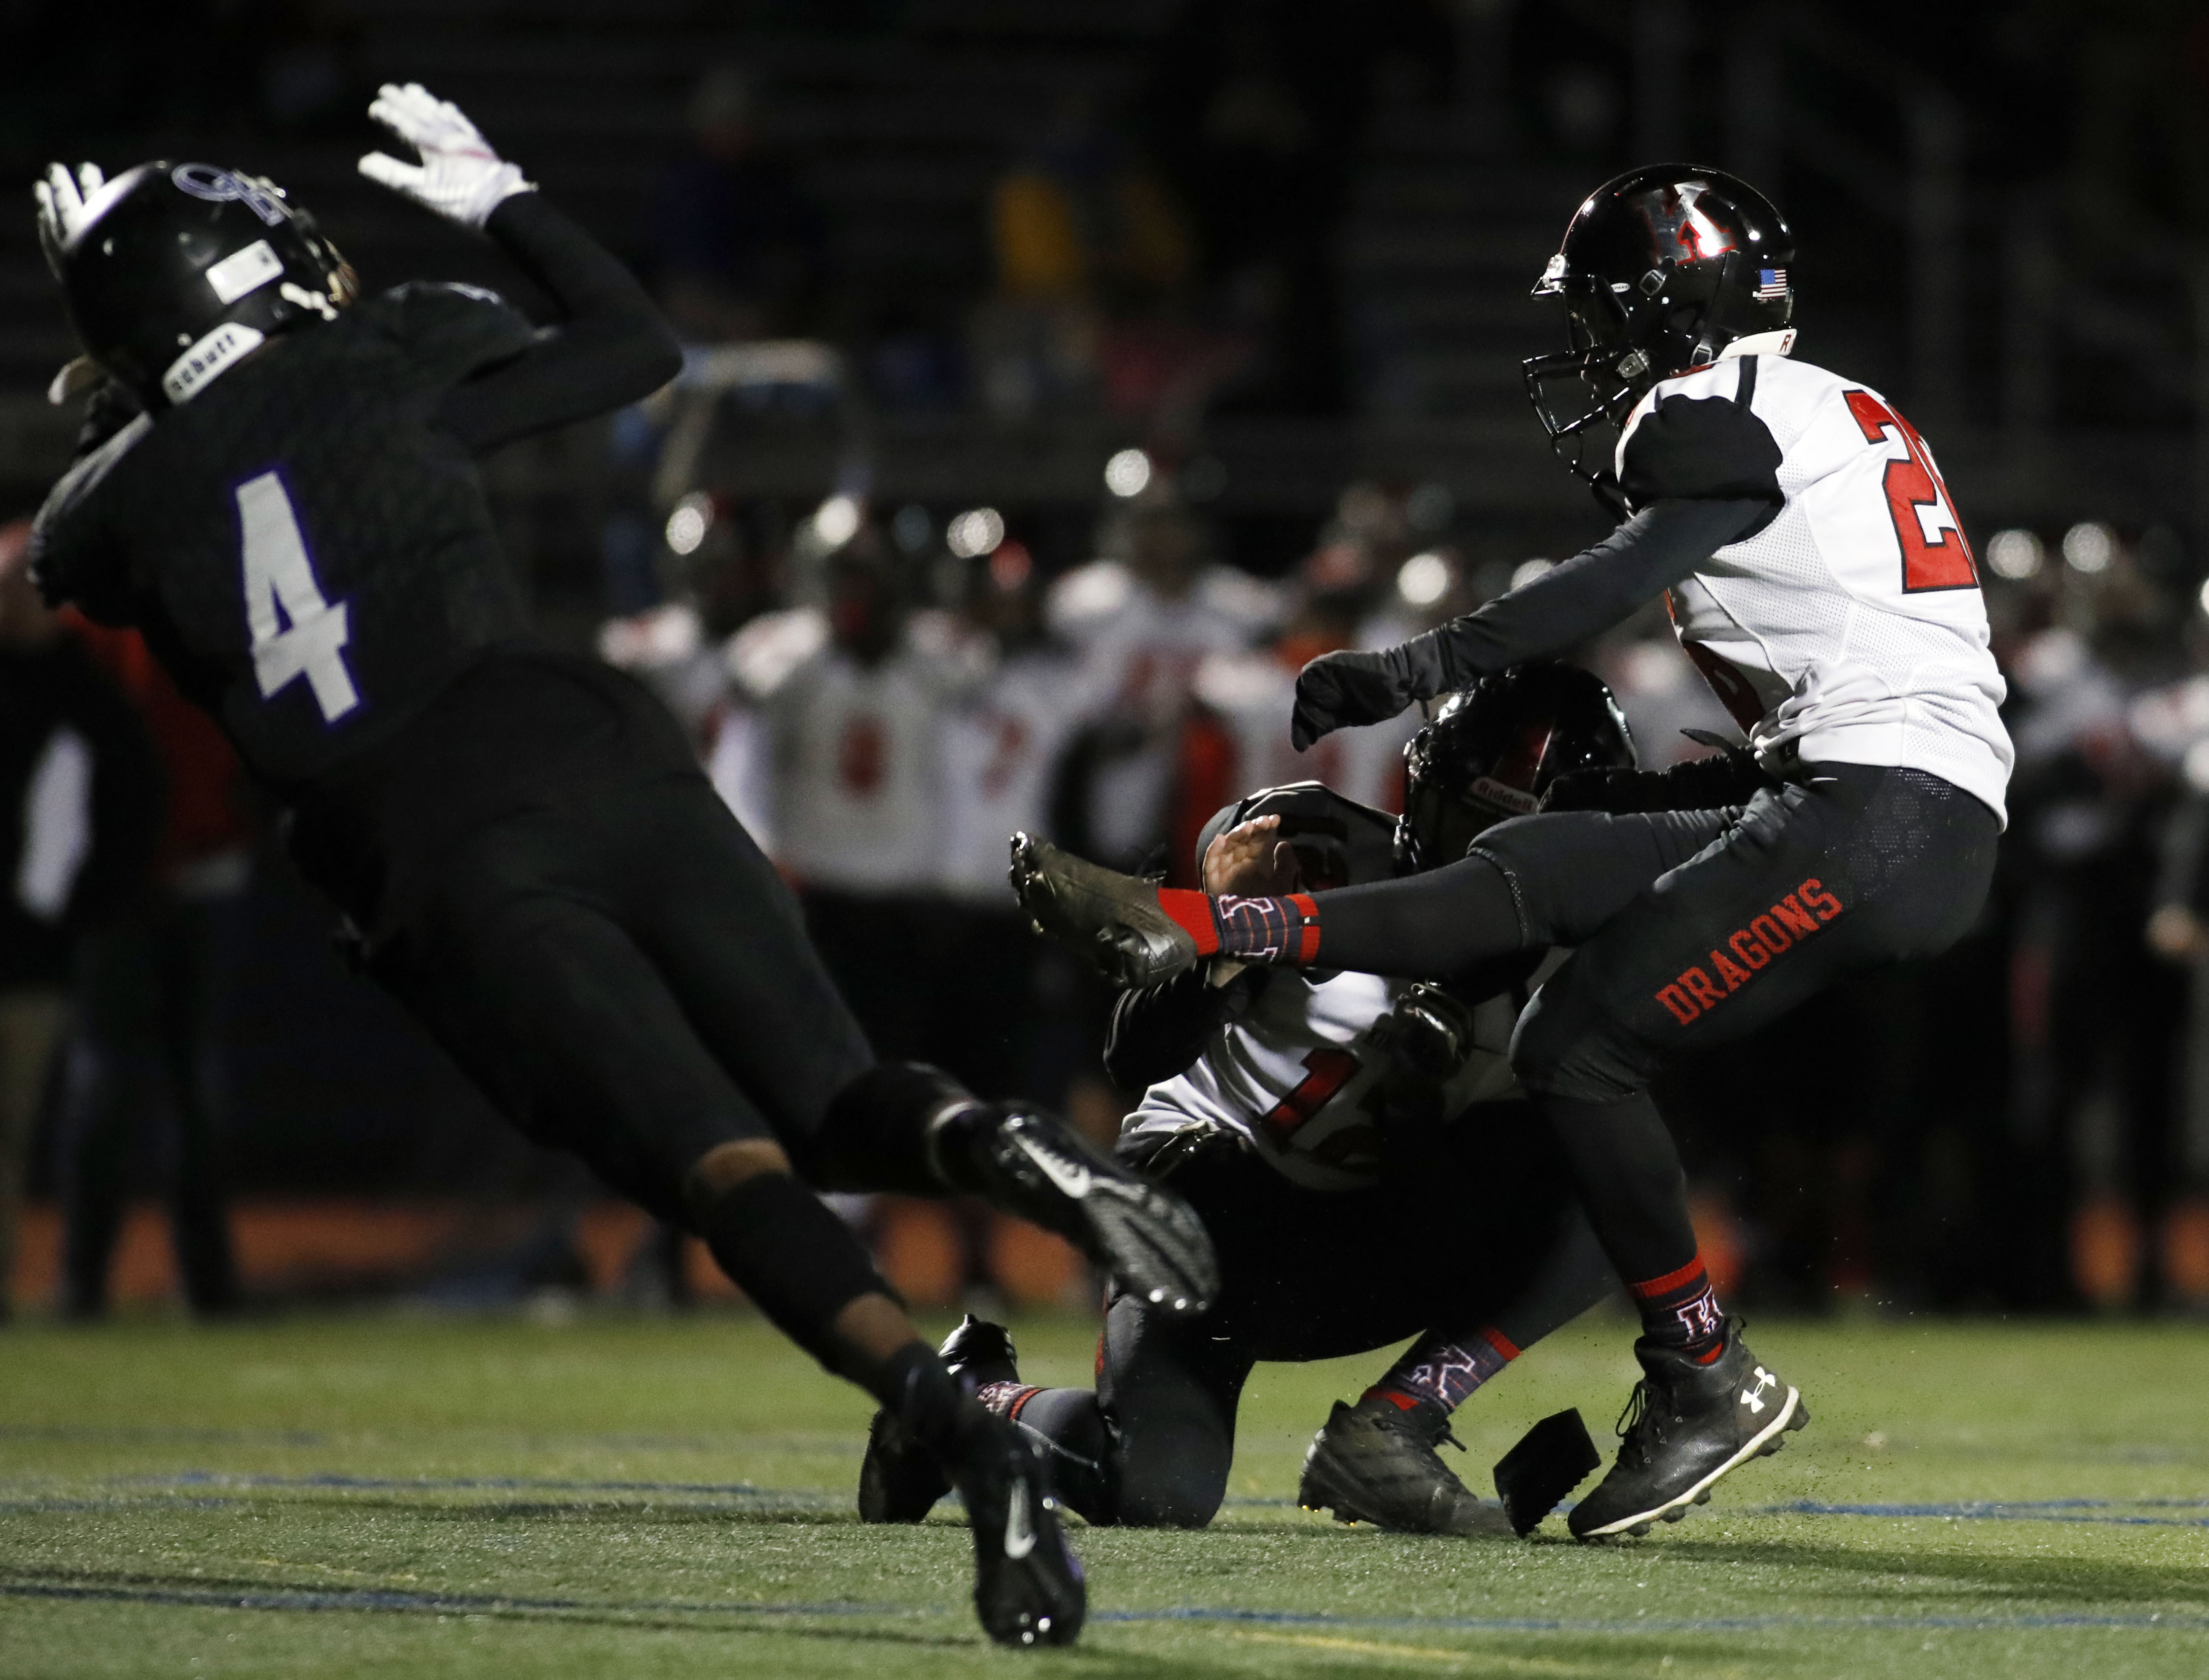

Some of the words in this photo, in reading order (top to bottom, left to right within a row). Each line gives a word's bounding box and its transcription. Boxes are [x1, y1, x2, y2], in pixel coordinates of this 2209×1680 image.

[1631, 180, 1737, 265] K
[1841, 388, 1985, 595] 2
[232, 467, 364, 726] 4
[1478, 779, 1533, 811] Riddell
[1654, 877, 1843, 1025] DRAGONS
